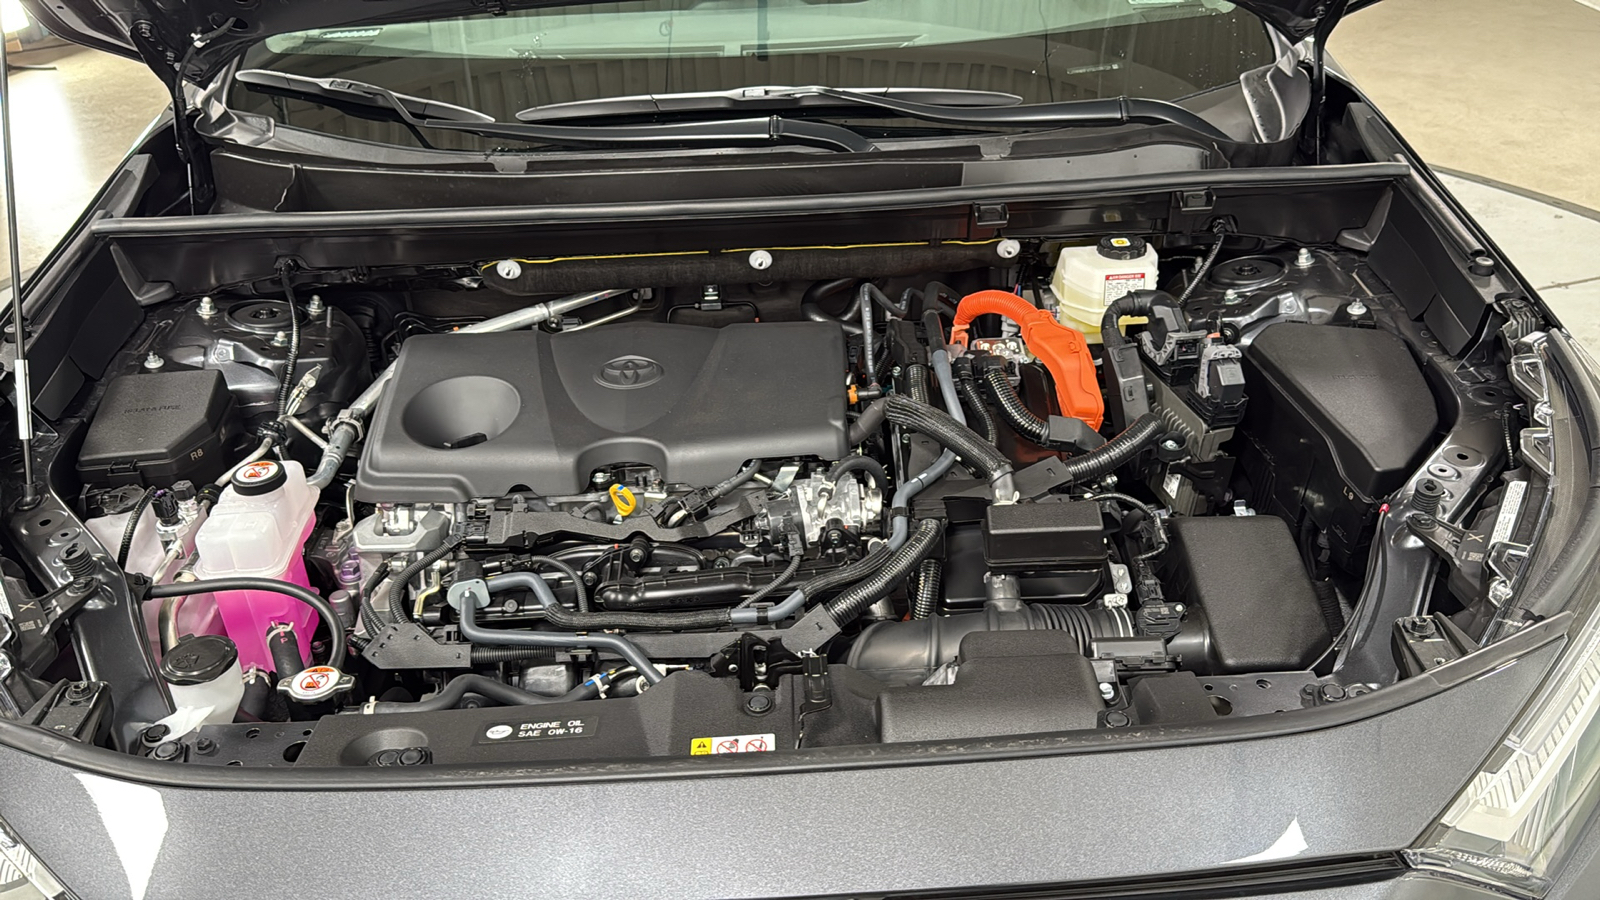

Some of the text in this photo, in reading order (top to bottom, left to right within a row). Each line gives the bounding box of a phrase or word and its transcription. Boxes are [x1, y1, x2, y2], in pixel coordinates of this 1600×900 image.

[190, 448, 204, 461] R8
[520, 719, 585, 731] ENGINE OIL
[517, 727, 583, 738] SAE 0W-16
